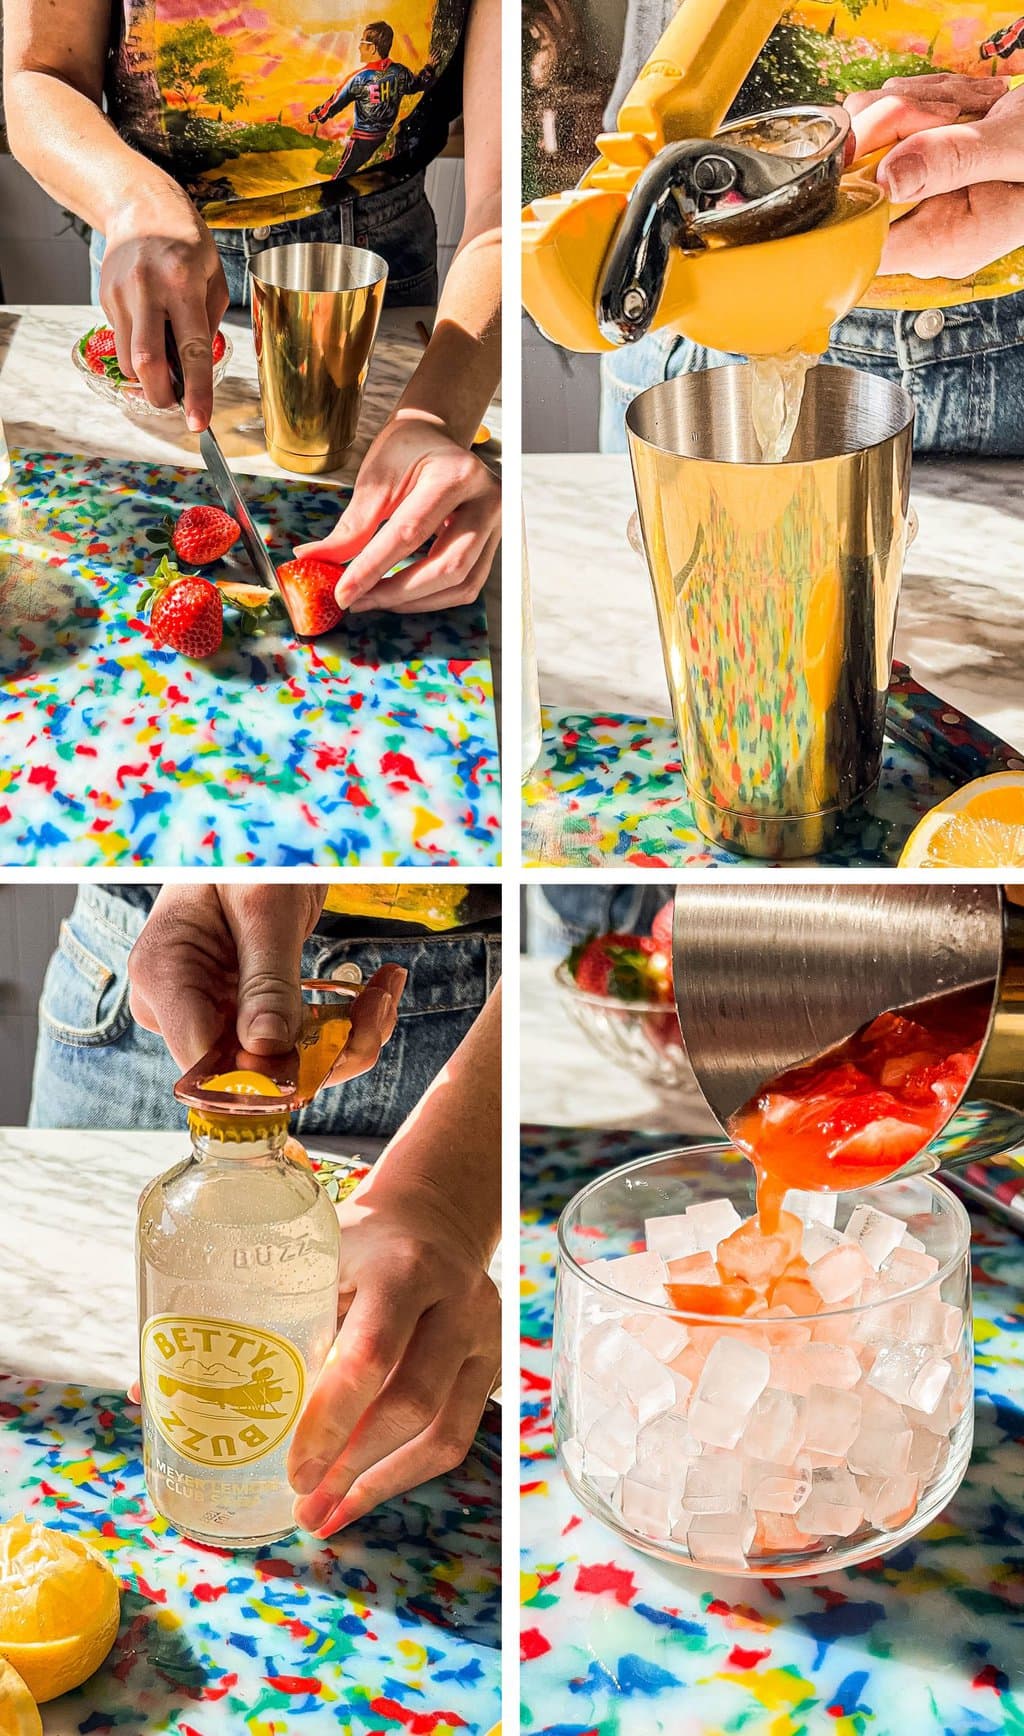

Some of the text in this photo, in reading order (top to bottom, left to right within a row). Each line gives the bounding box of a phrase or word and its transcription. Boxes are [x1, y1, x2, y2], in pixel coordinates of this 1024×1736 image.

[233, 1232, 313, 1269] BUZZ
[153, 1327, 279, 1368] BETTY
[160, 1410, 269, 1456] BUZZ
[210, 1480, 279, 1495] LEM
